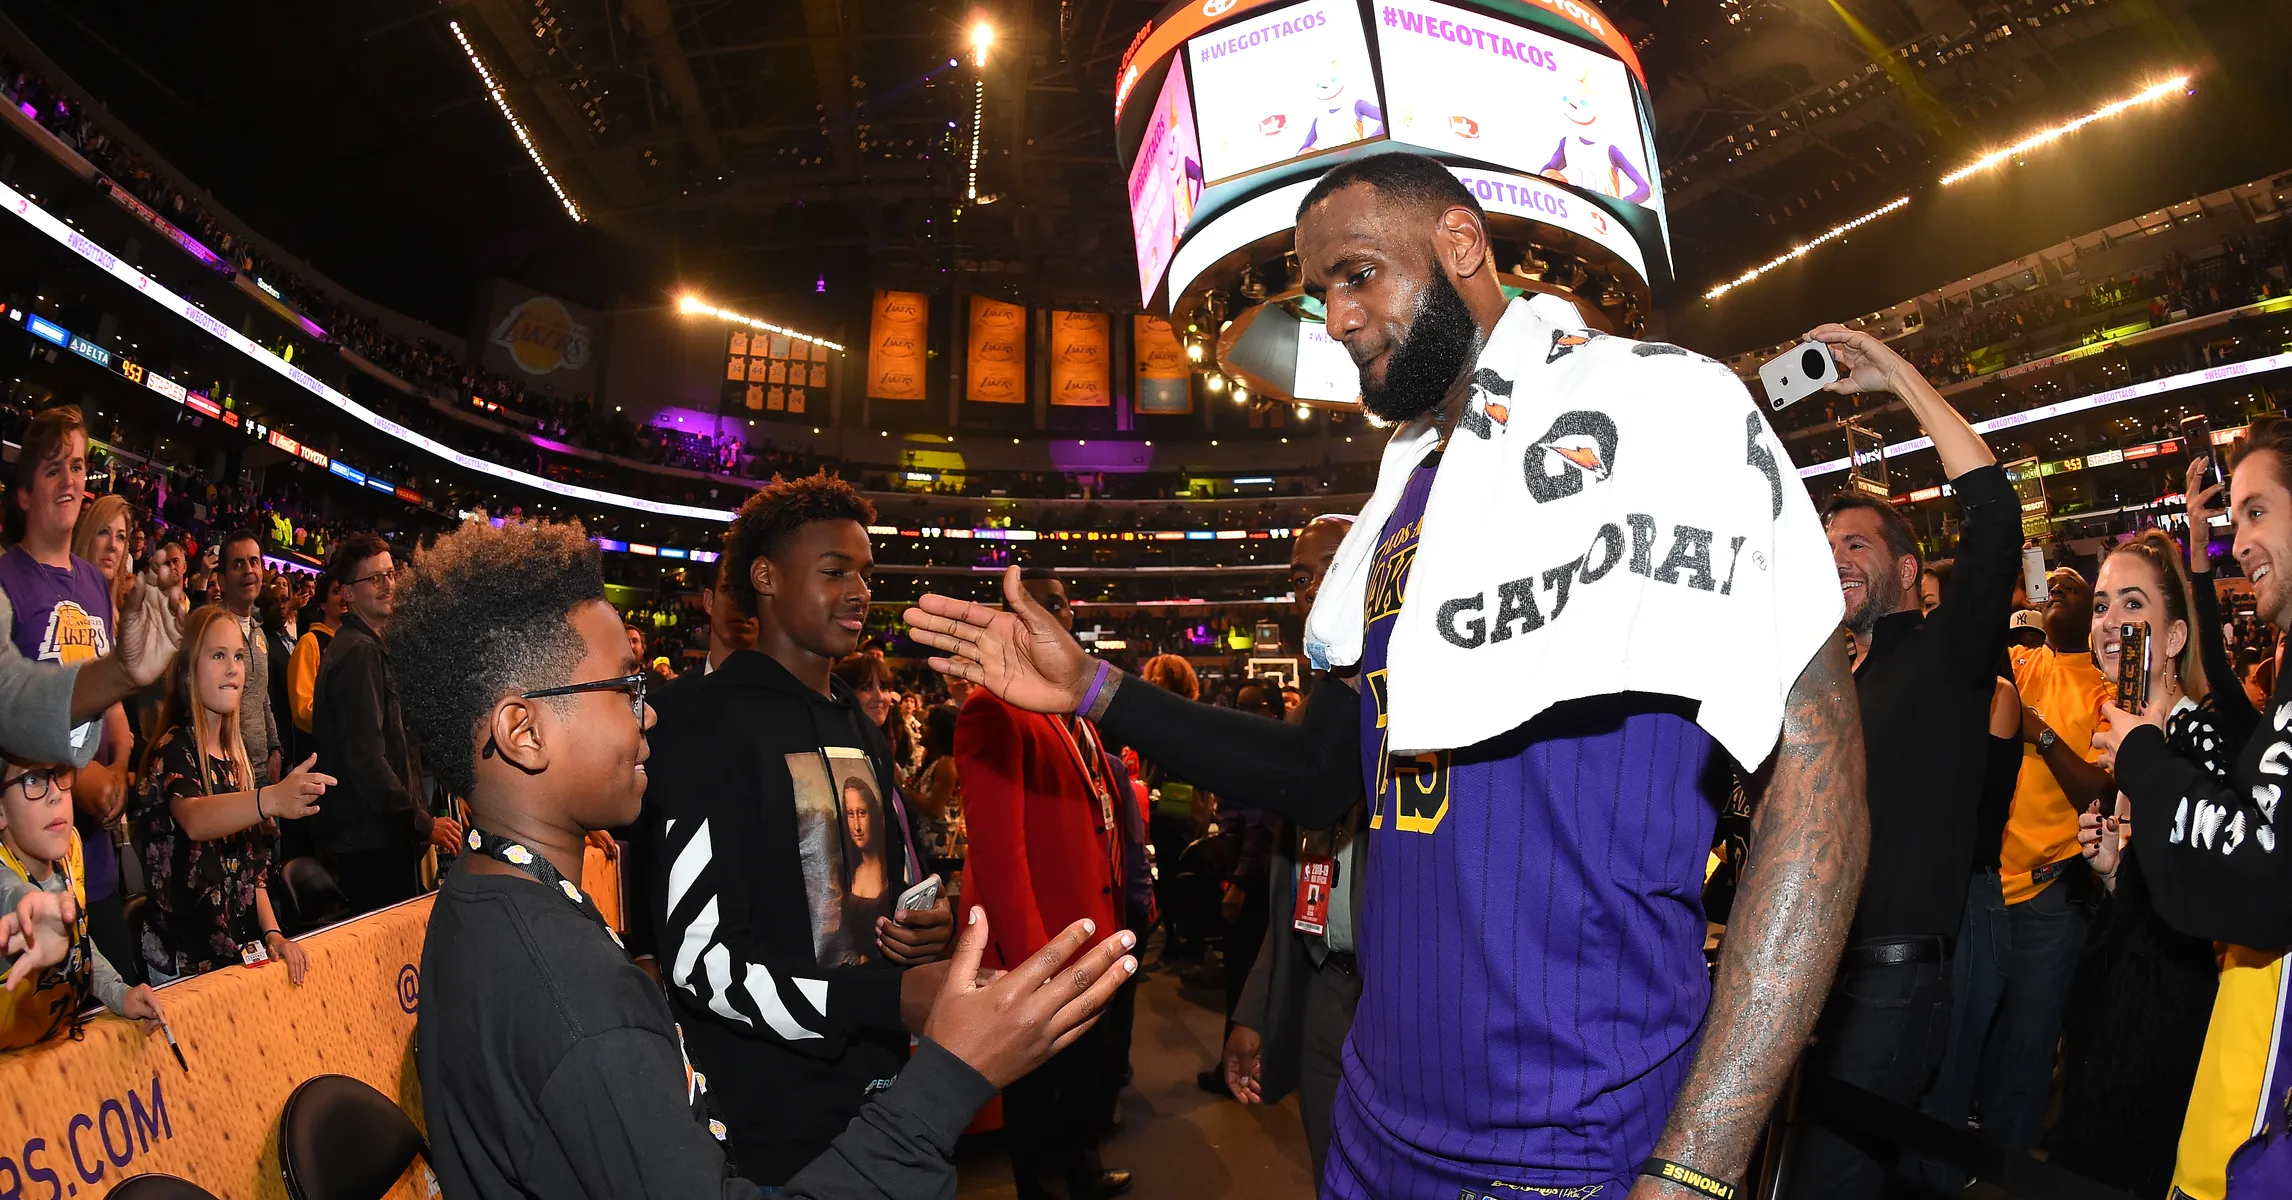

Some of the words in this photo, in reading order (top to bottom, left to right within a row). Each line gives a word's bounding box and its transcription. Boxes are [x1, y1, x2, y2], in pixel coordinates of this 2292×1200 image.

[1200, 10, 1327, 63] #WEGOTTACOS
[1383, 5, 1558, 72] #WEGOTTACOS
[1460, 178, 1569, 219] GOTTACOS
[67, 231, 117, 271] #WEGOTTACOS
[185, 306, 229, 339] #WEGOTTACOS
[79, 341, 109, 365] DELTA
[288, 367, 325, 395] #WEGOTTACOS
[2204, 364, 2248, 380] #WEGOTTACOS
[148, 374, 185, 402] STAPLES
[2093, 388, 2137, 404] #WEGOTTACOS
[374, 415, 408, 439] #WEGOTTACOS
[1987, 413, 2028, 430] #WEGOTTACOS
[300, 446, 328, 468] TOYOTA
[1890, 439, 1927, 455] #WEGOTTACOS
[2088, 451, 2123, 466] STAPLES
[1436, 511, 1747, 650] GATORA
[43, 615, 105, 659] LAKERS
[0, 1076, 173, 1200] RS.COM
[1662, 1163, 1728, 1197] PROMISE
